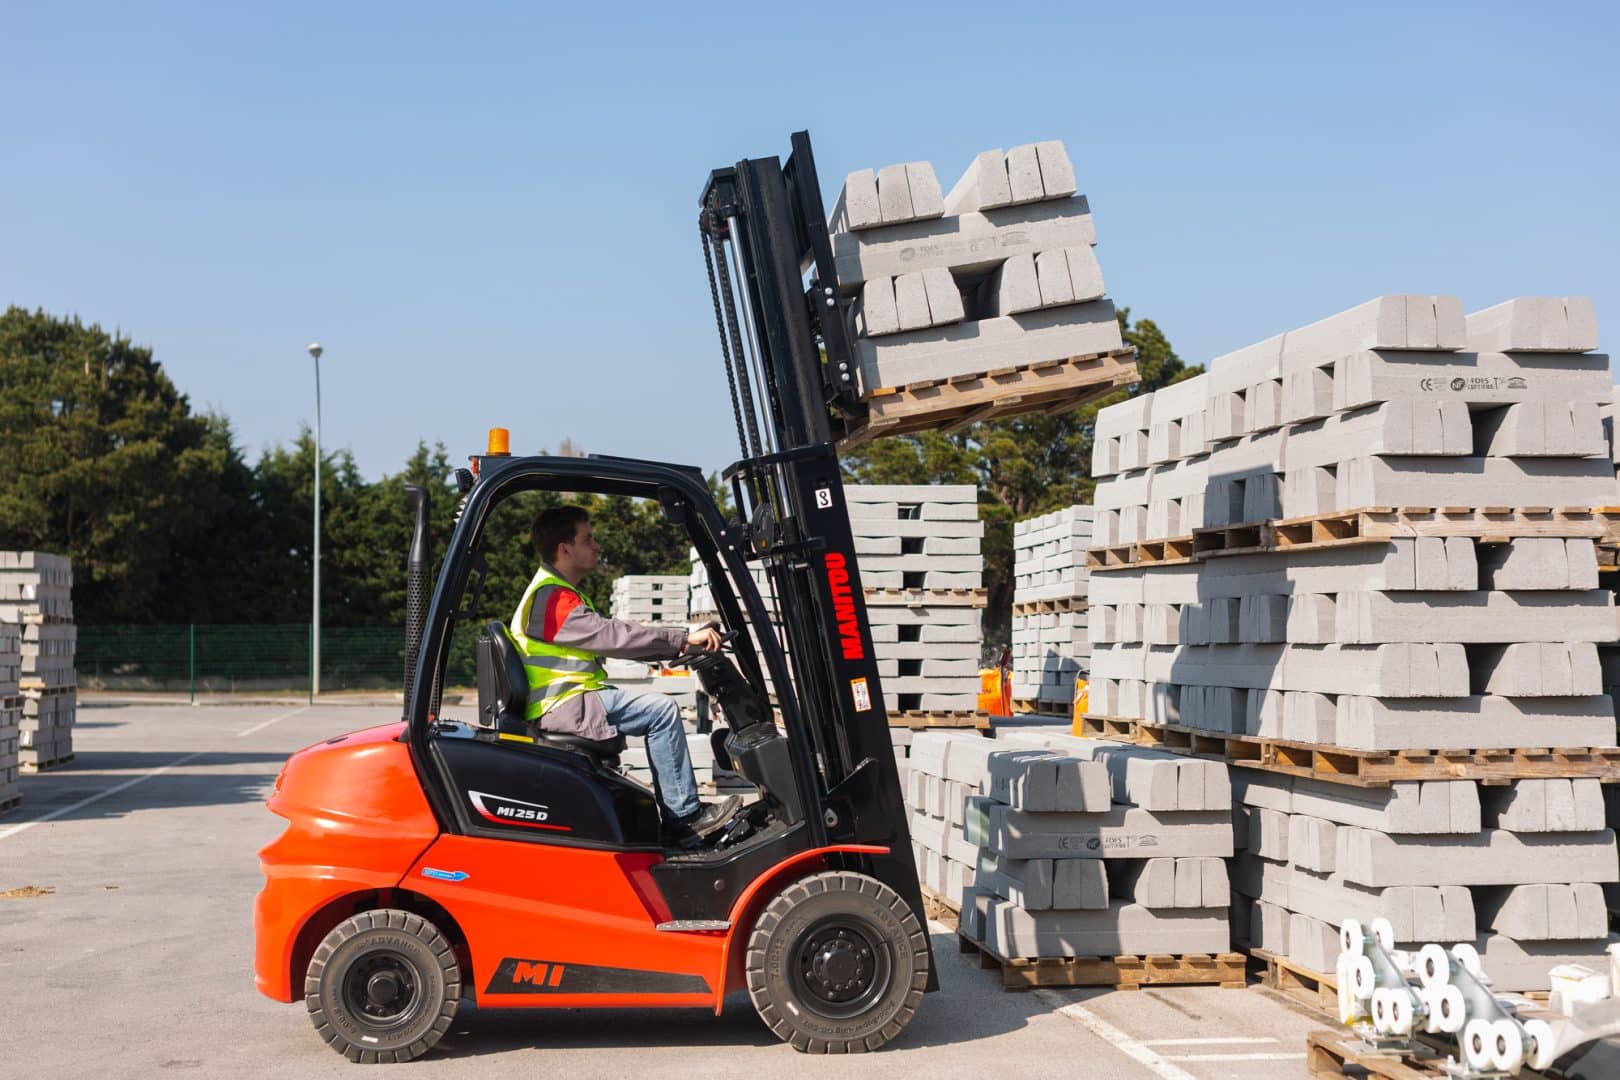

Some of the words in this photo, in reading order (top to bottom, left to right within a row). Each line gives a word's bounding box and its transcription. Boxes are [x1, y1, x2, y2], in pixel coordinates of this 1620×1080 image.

[1420, 378, 1433, 391] CE
[825, 552, 865, 660] MANITOU
[512, 961, 565, 987] MI
